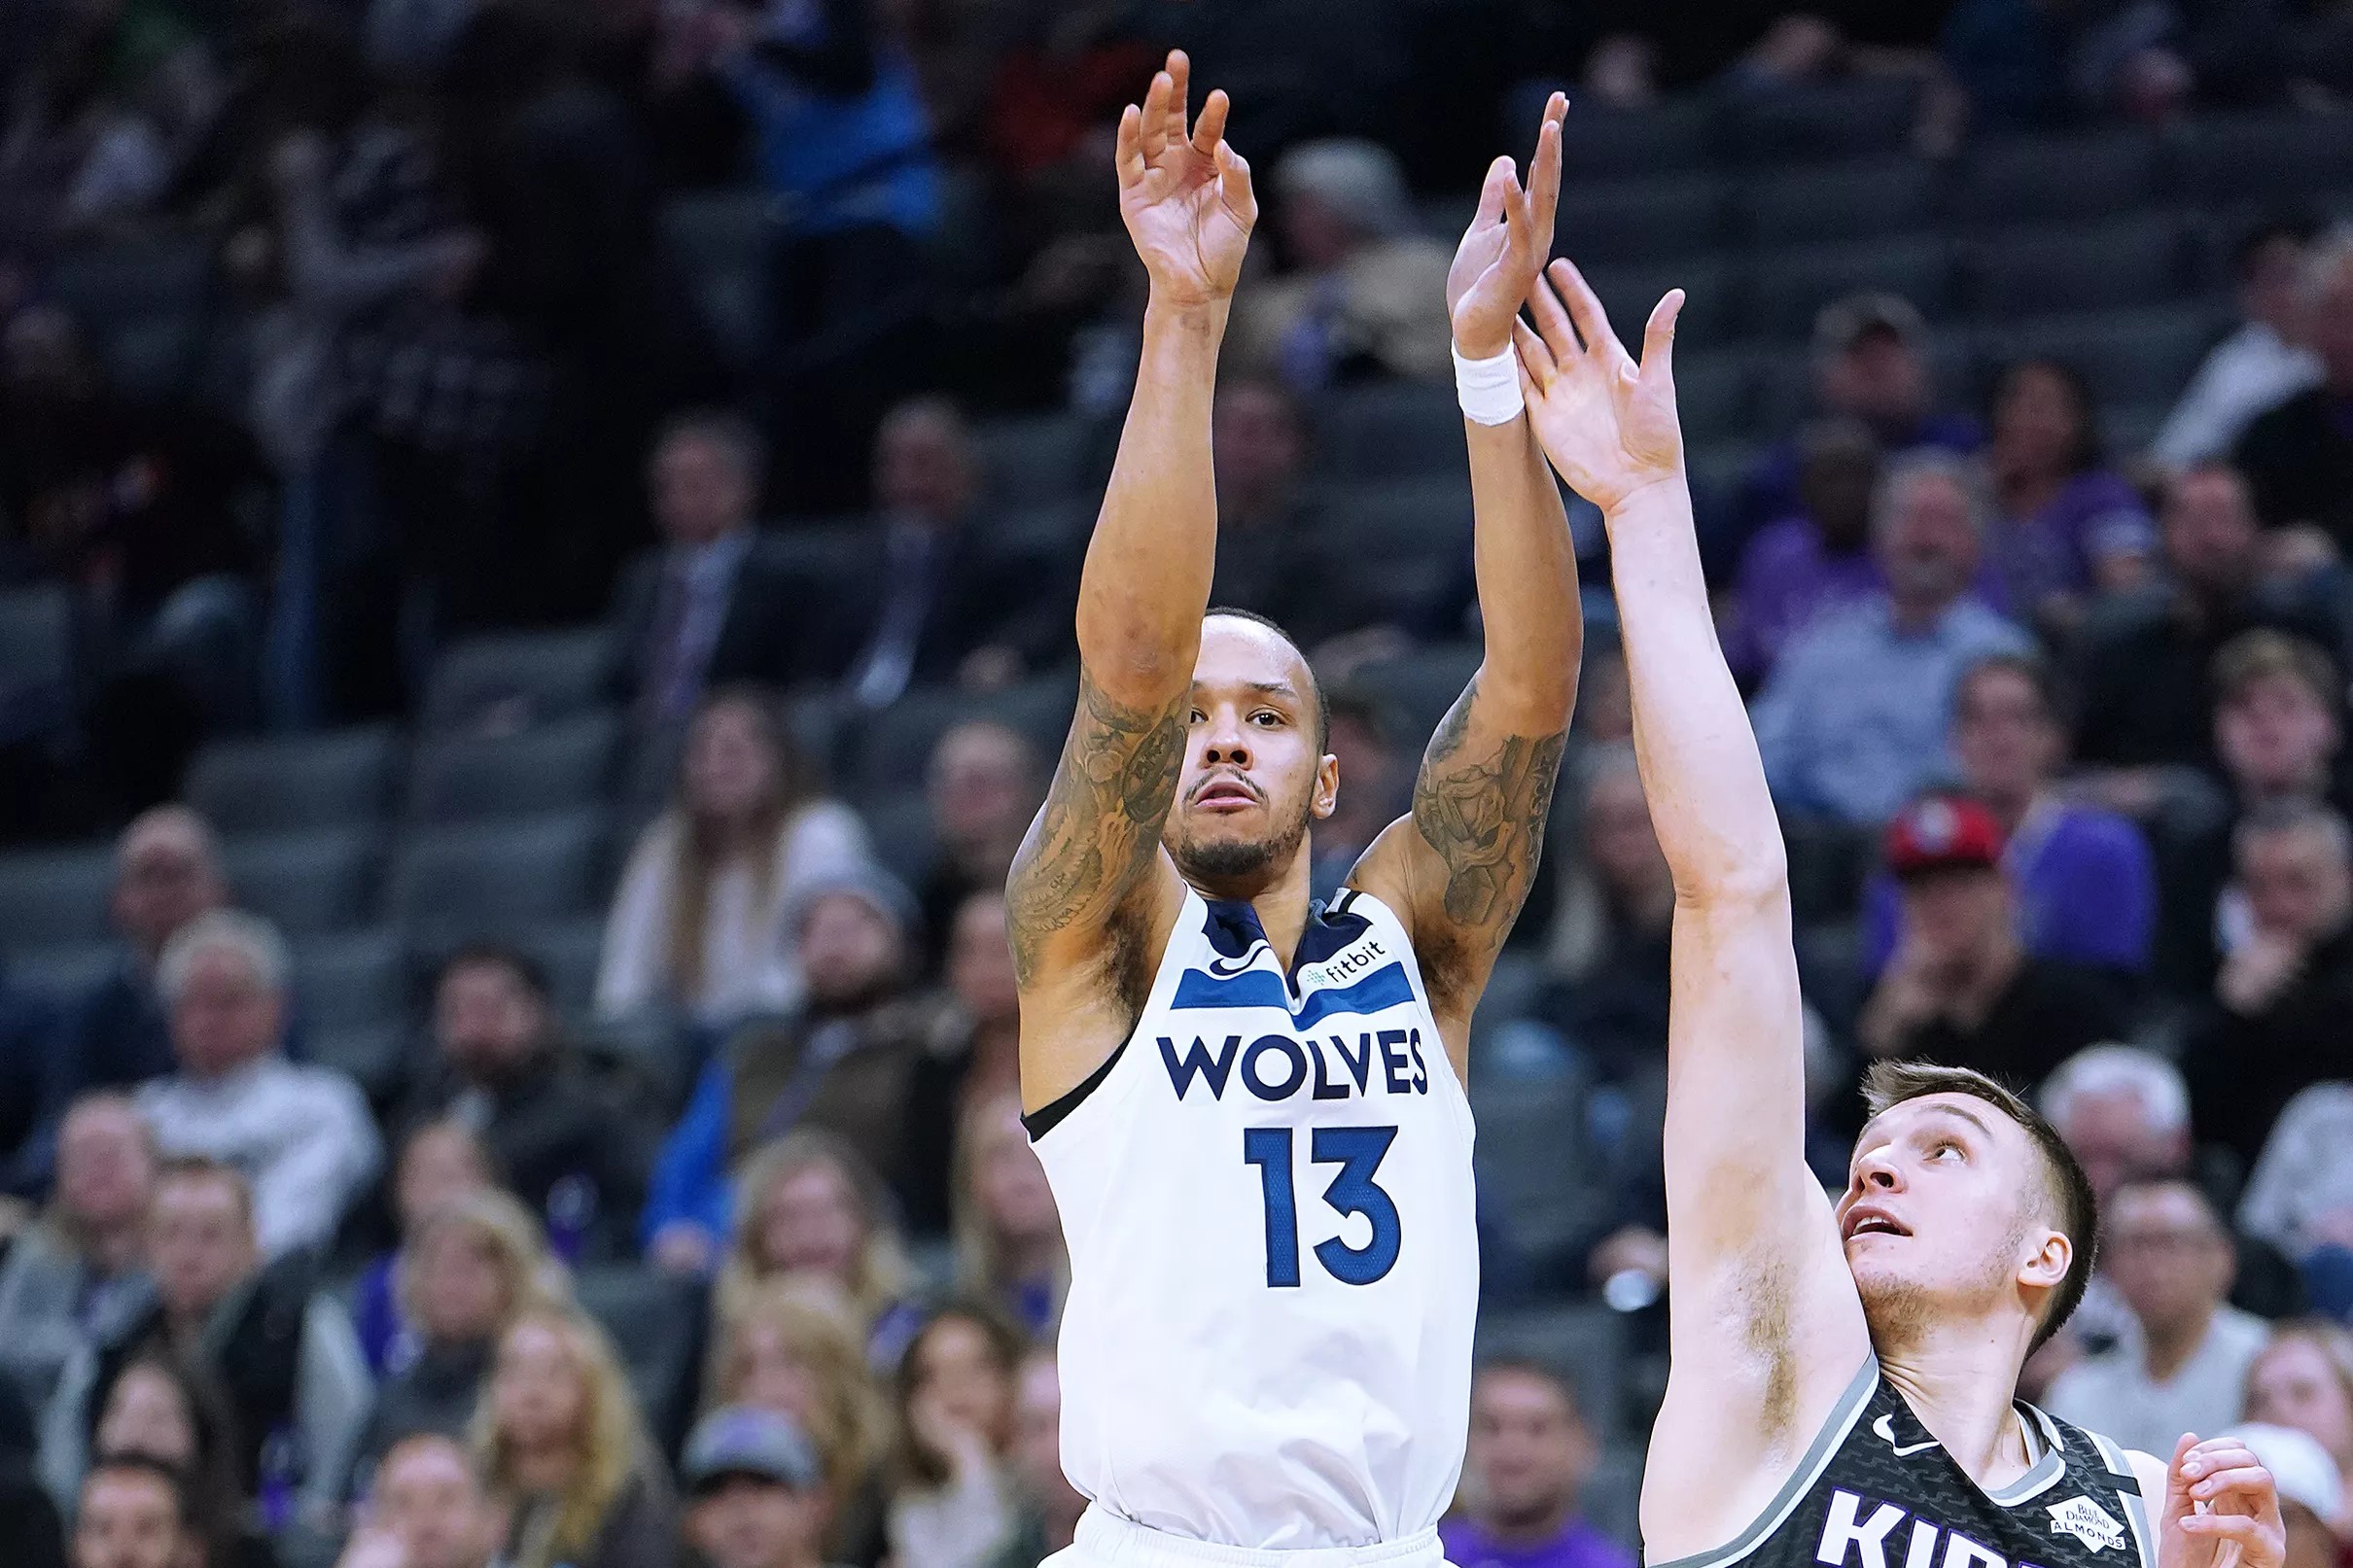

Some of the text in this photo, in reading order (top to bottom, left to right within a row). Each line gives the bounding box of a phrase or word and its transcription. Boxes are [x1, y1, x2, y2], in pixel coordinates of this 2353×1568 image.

[1325, 941, 1386, 983] fitbit
[1156, 1027, 1428, 1101] WOLVES
[1244, 1125, 1402, 1288] 13
[2065, 1510, 2110, 1529] DIAMOND
[2077, 1503, 2098, 1516] BLUE
[2054, 1521, 2124, 1549] ALMONDS
